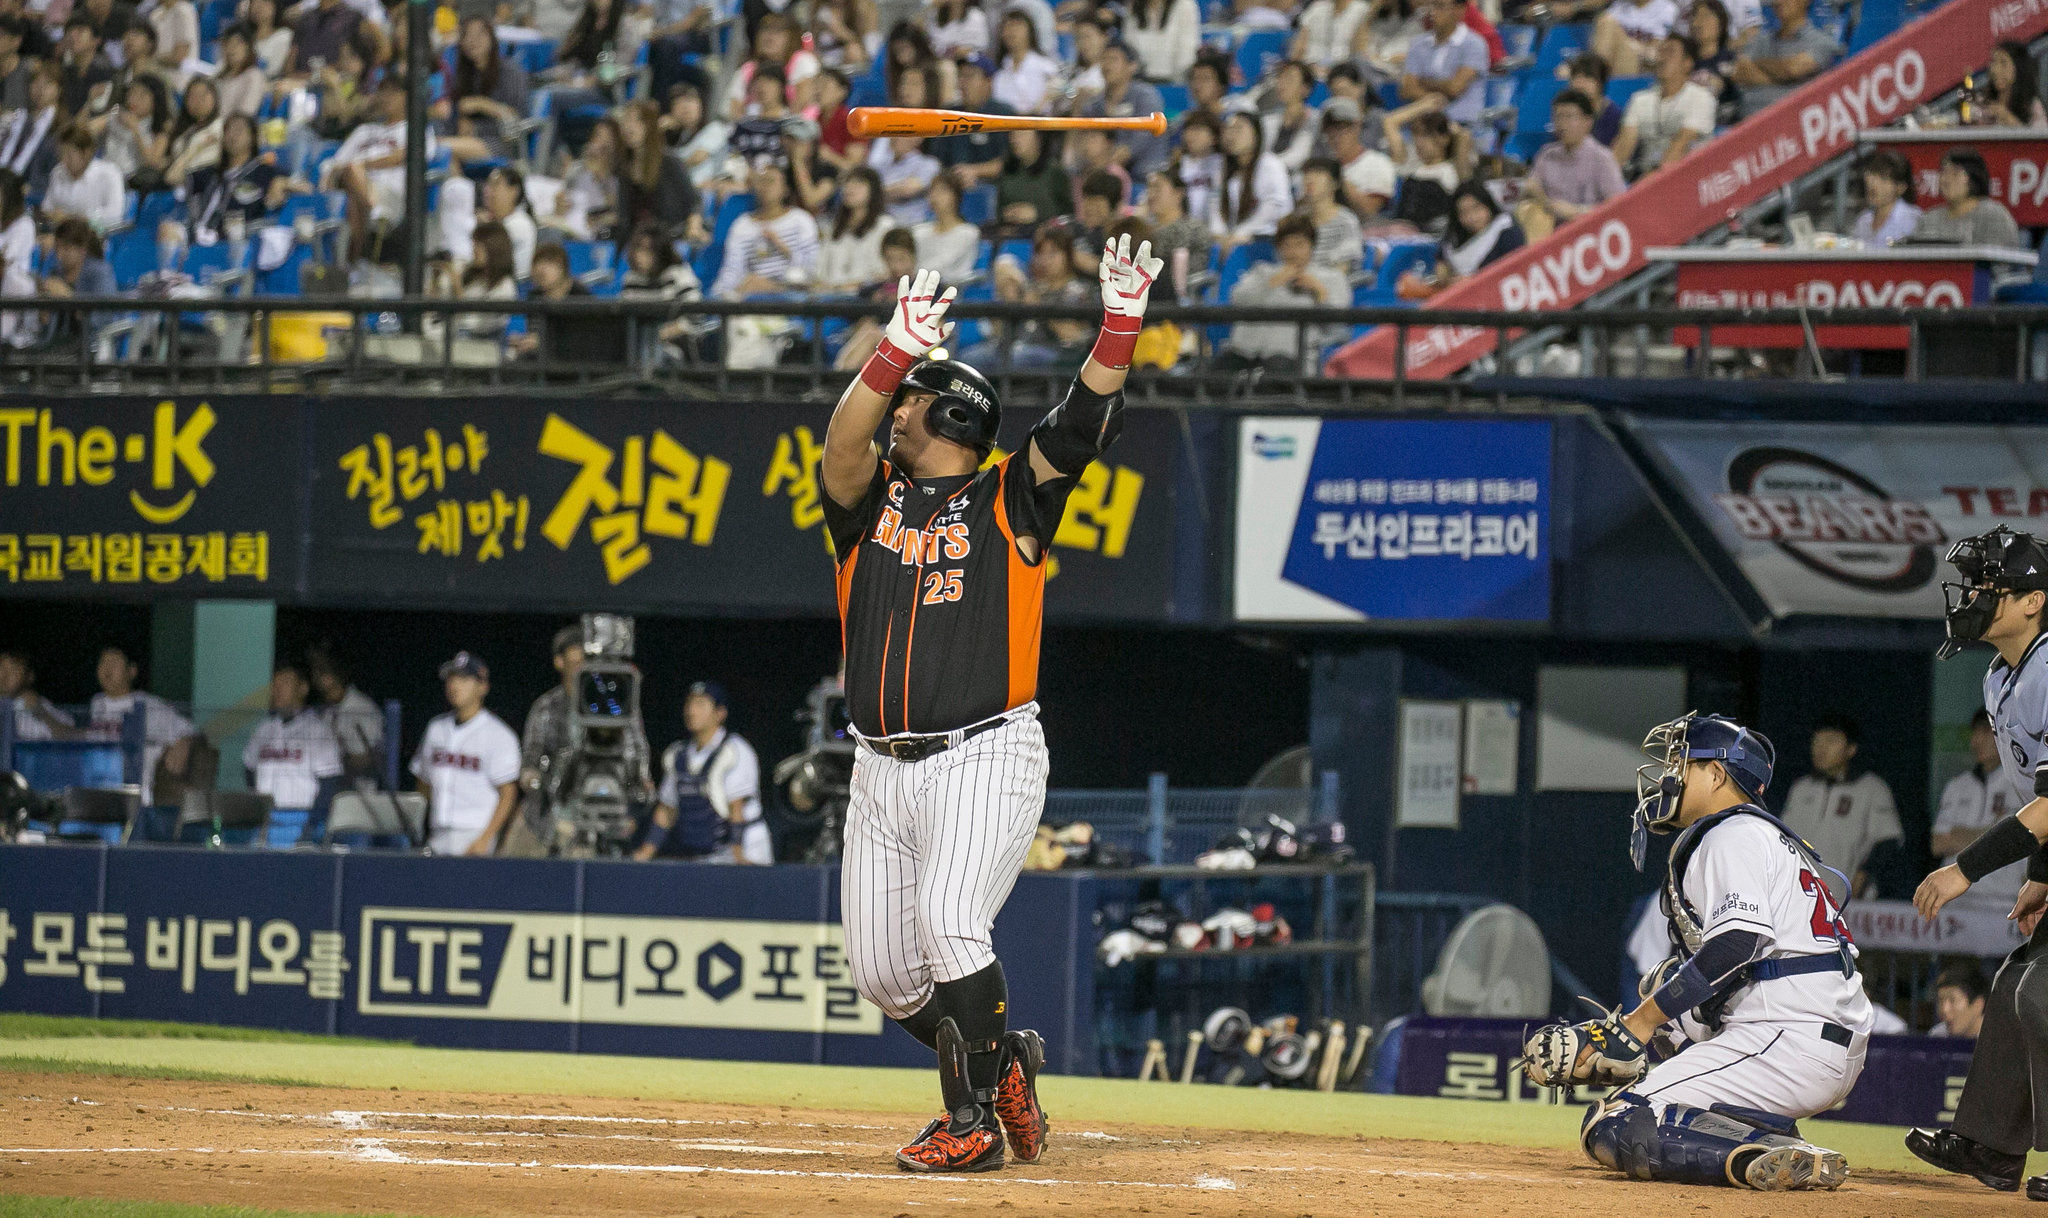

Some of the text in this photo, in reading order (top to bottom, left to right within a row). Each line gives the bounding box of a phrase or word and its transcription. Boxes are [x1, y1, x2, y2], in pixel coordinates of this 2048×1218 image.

[1800, 47, 1926, 158] PAYCO
[1500, 219, 1632, 312] PAYCO
[951, 378, 992, 413] 클라우드
[338, 422, 490, 530] 질러야
[537, 412, 732, 585] 질러
[870, 504, 971, 568] GIANTS
[1312, 510, 1538, 560] 두산인프라코어
[1714, 492, 1949, 547] BEARS
[922, 568, 964, 606] 25
[1712, 899, 1759, 919] 인프라코어
[24, 911, 134, 994] 모든
[145, 914, 351, 1000] 비디오를
[379, 925, 484, 997] LTE
[526, 934, 686, 1007] 비디오
